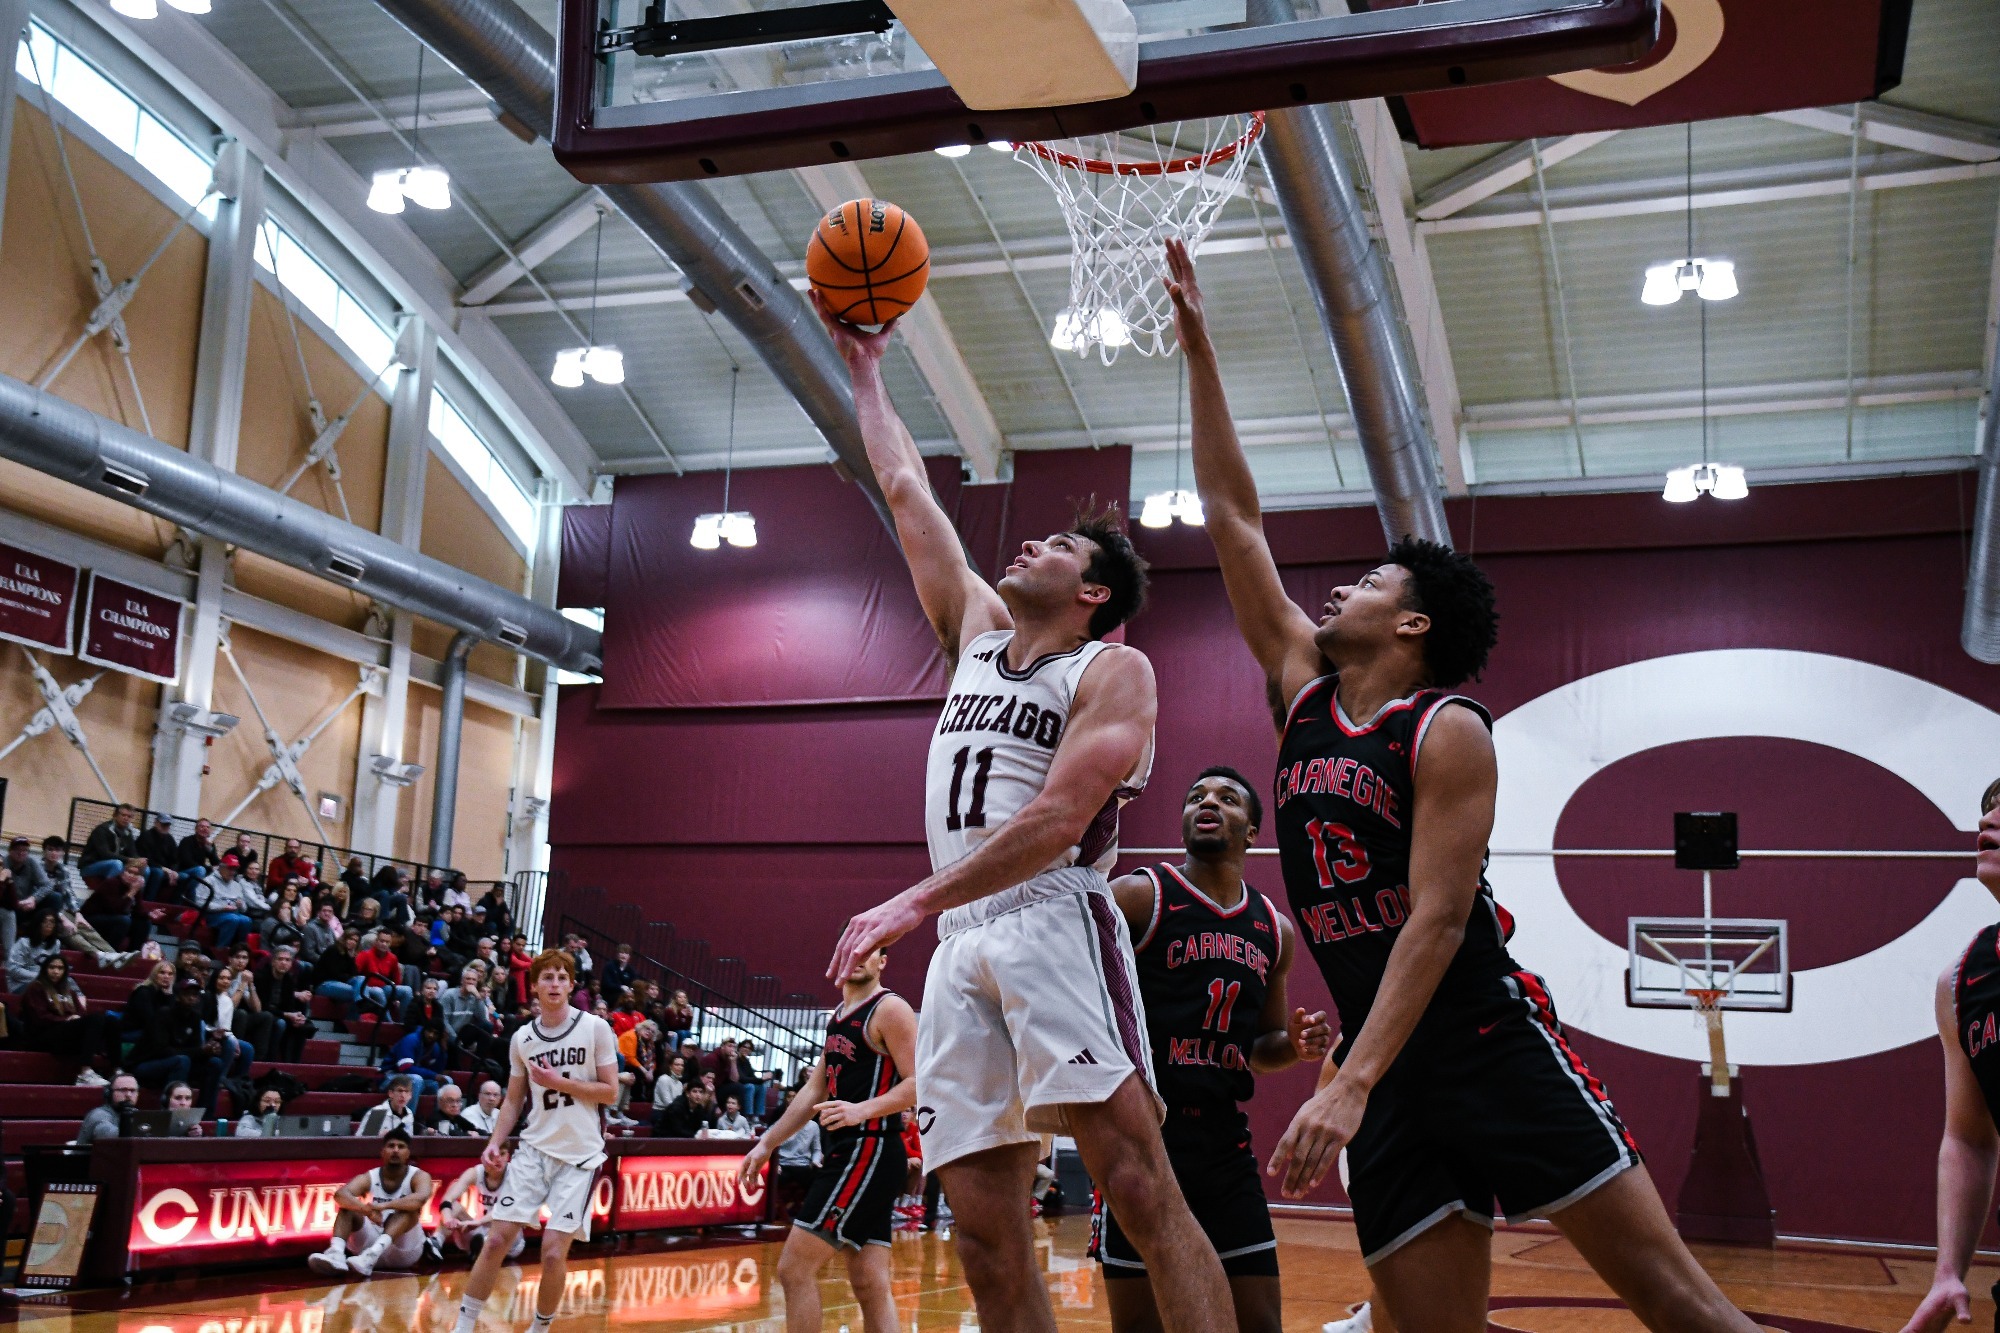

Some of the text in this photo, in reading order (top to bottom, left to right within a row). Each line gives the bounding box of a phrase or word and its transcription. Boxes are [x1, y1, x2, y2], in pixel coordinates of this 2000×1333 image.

[0, 575, 62, 606] HAMPIONS
[100, 607, 171, 640] CHAMPIONS
[939, 694, 1062, 749] CHICAGO
[946, 745, 996, 833] 11
[1276, 757, 1401, 830] CARNEGIE
[1305, 816, 1373, 889] 13
[1167, 932, 1270, 987] CARNEGIE
[1202, 977, 1241, 1033] 11
[48, 1183, 98, 1193] MAROONS
[620, 1169, 736, 1213] MAROONS
